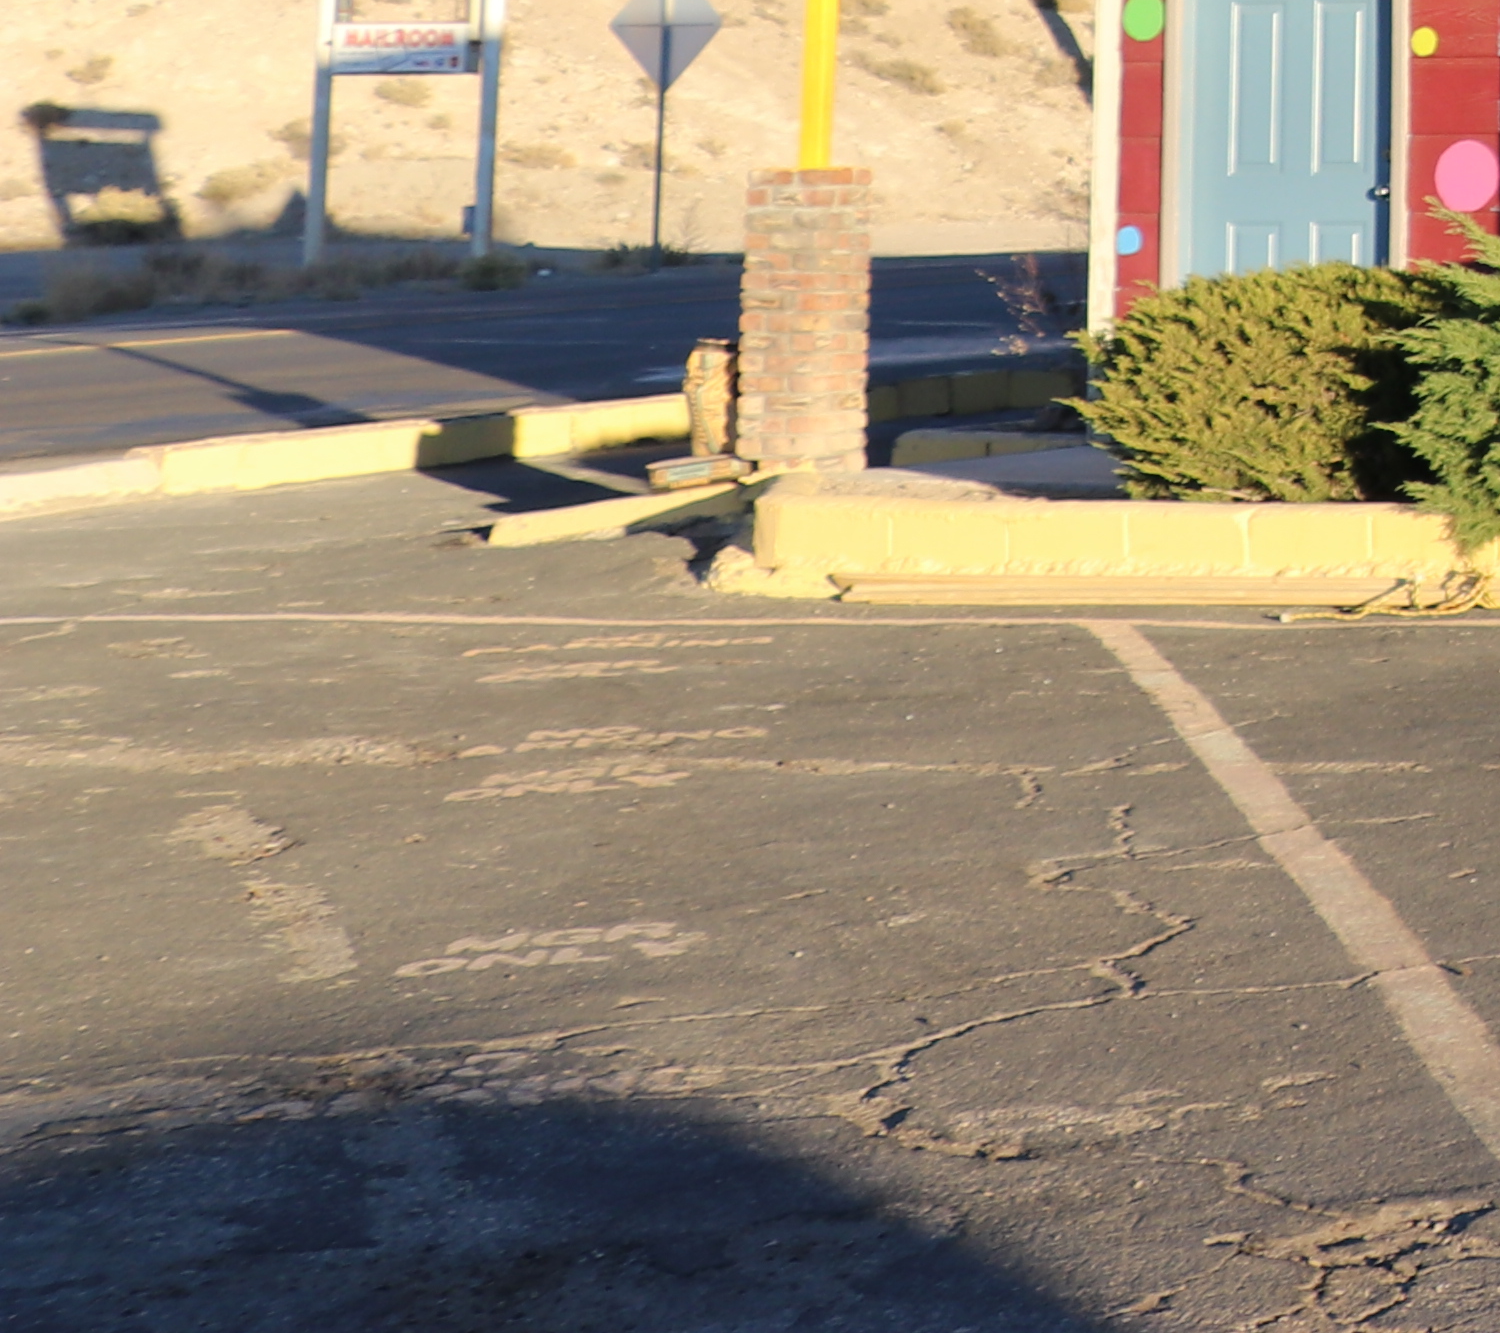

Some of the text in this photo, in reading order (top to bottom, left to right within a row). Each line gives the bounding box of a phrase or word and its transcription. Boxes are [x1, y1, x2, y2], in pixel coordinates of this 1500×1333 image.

[443, 771, 692, 802] ONLY
[394, 931, 707, 977] ONLY
[445, 921, 678, 955] MGR
